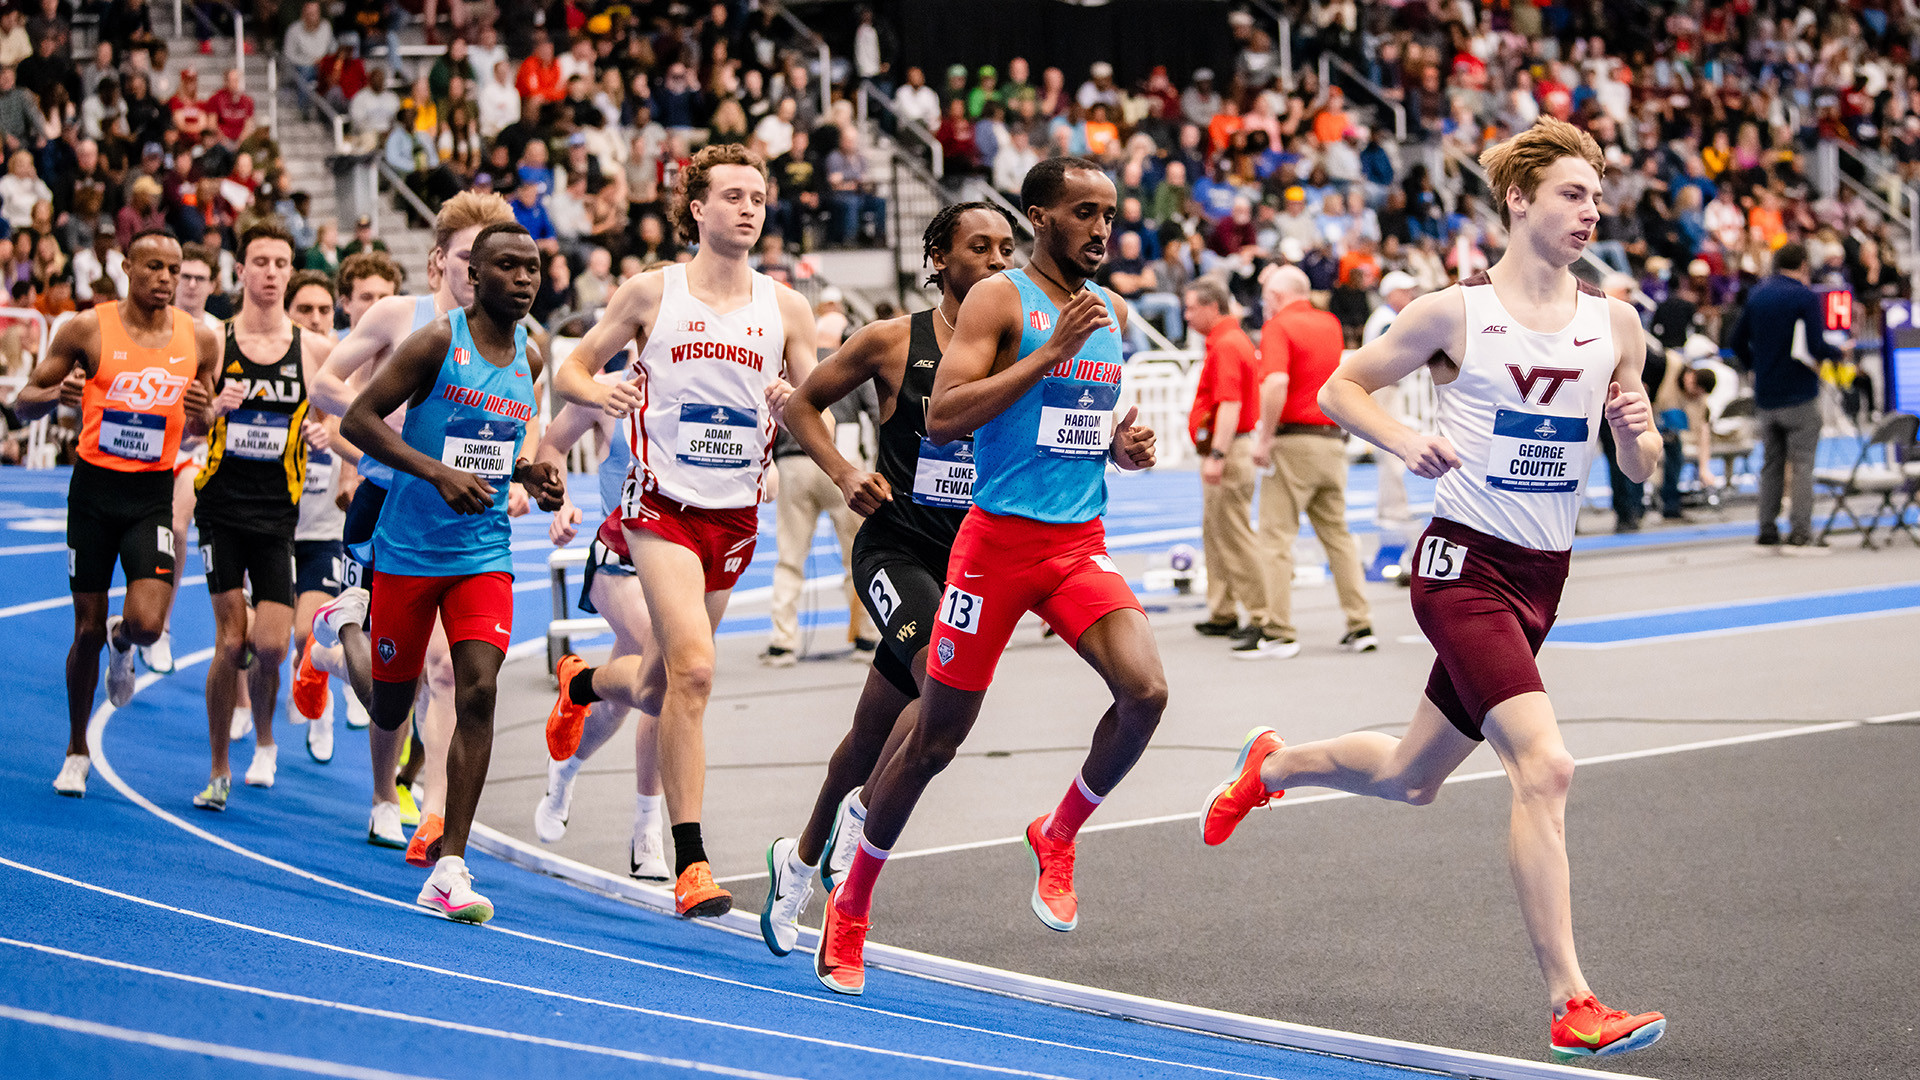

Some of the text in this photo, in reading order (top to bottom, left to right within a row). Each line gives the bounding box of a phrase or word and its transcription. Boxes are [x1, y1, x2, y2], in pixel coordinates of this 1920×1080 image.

[1481, 325, 1507, 334] ACC
[671, 341, 764, 373] WISCONSIN
[912, 359, 935, 368] ACC
[107, 367, 188, 410] OSU
[1505, 363, 1584, 406] VT
[442, 383, 484, 408] NEW
[1064, 414, 1101, 428] HABTOM
[120, 428, 145, 439] BRIAN
[247, 430, 269, 439] COLIN
[704, 428, 732, 440] ADAM
[1056, 428, 1101, 446] SAMUEL
[113, 437, 150, 452] MUSAU
[234, 439, 280, 451] SAHLMAN
[463, 443, 502, 456] ISHMAEL
[689, 439, 743, 456] SPENCER
[1518, 443, 1565, 460] GEORGE
[454, 455, 505, 471] KIPKURUI
[1509, 459, 1567, 477] COUTTIE
[948, 466, 974, 480] LUKE
[1426, 538, 1458, 578] 15
[343, 557, 357, 586] 16
[871, 578, 893, 620] 3
[947, 590, 974, 629] 13
[896, 620, 918, 643] WF
